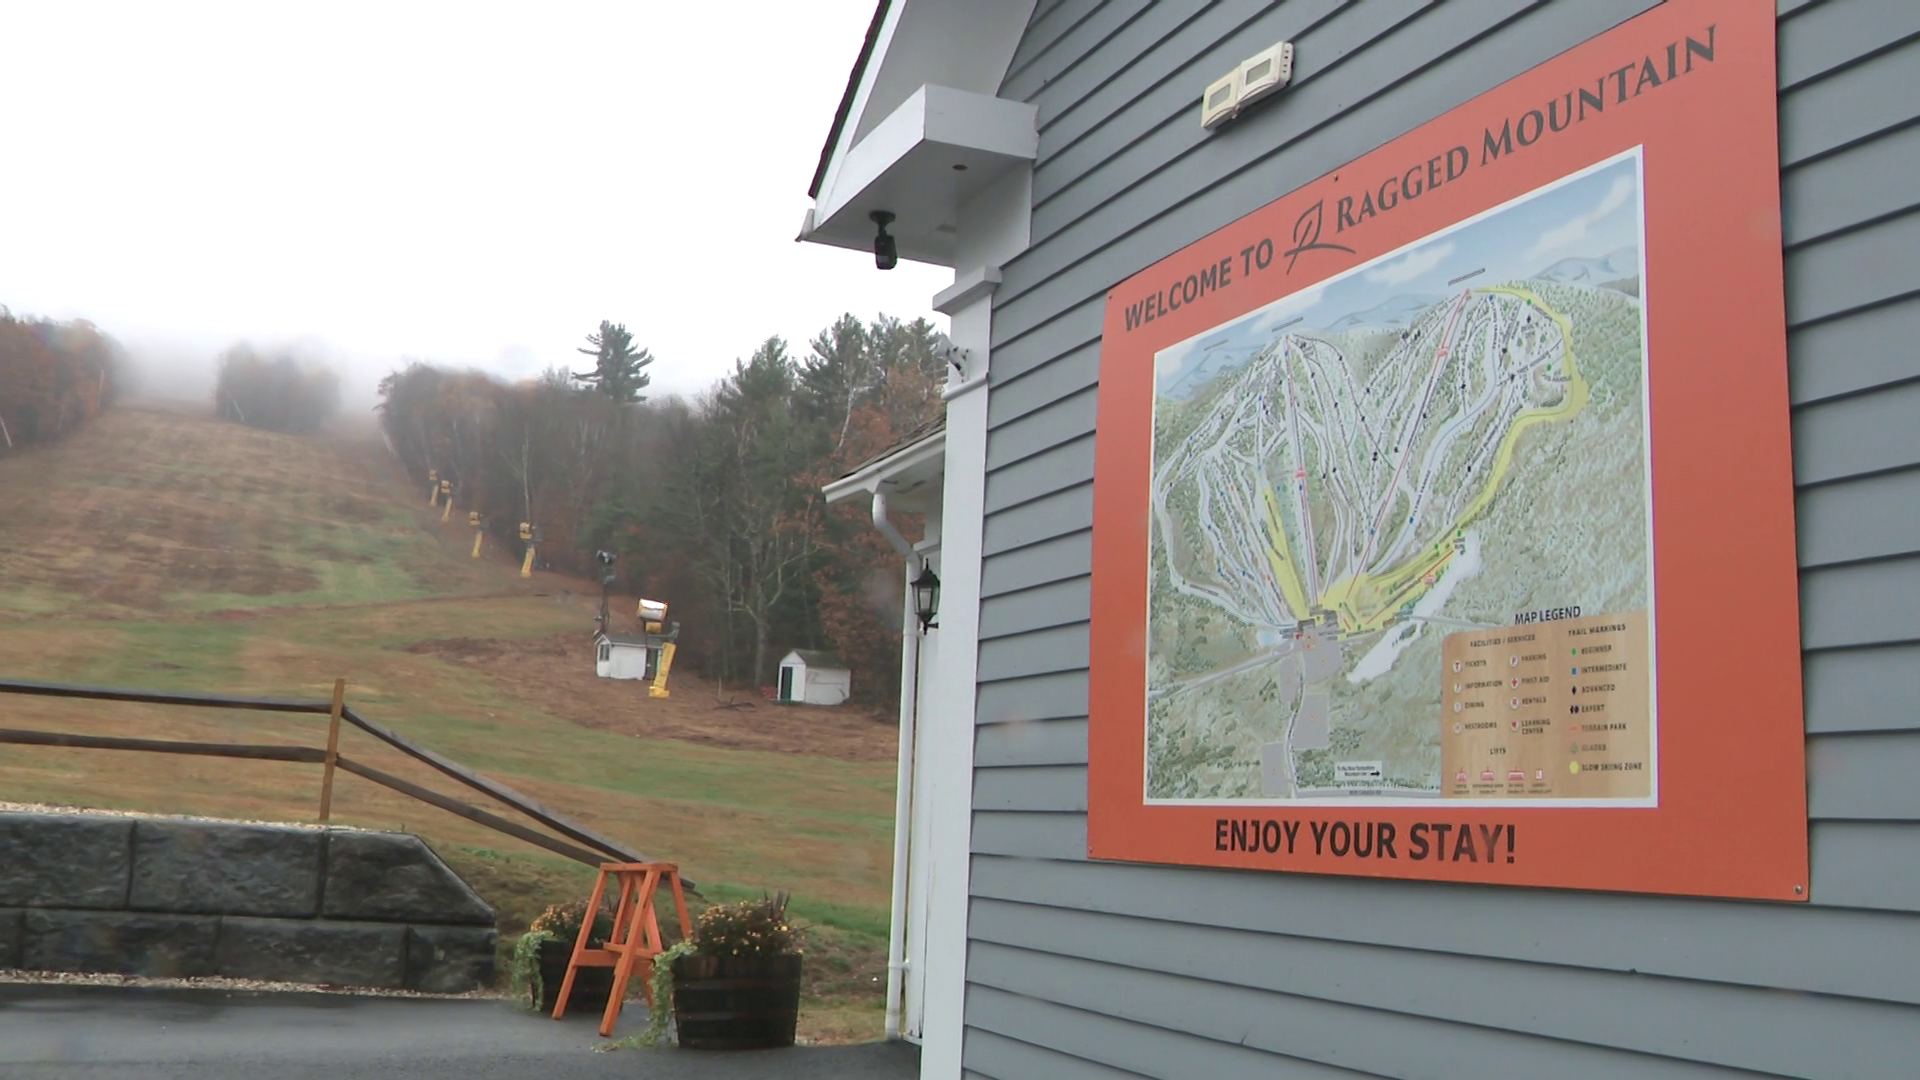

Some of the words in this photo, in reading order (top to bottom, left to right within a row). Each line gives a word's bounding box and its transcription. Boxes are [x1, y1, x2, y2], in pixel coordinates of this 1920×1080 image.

[1125, 256, 1232, 331] WELCOME
[1240, 238, 1274, 276] TO
[1336, 146, 1469, 233] RAGGED
[1480, 24, 1716, 167] MOUNTAIN
[1514, 611, 1537, 625] MAP
[1539, 606, 1581, 622] LEGEND
[1568, 628, 1587, 636] TRAIL
[1589, 623, 1626, 634] MARKINGS
[1581, 645, 1612, 655] BEGINNER
[1581, 663, 1627, 674] INTERMEDIATE
[1465, 680, 1503, 689] INFORMATION
[1581, 684, 1616, 693] ADVANCED
[1581, 704, 1605, 713] EXPERT
[1624, 762, 1642, 770] ZONE
[1215, 819, 1301, 854] ENJOY
[1310, 820, 1398, 860] YOUR
[1408, 822, 1516, 864] STAY!
